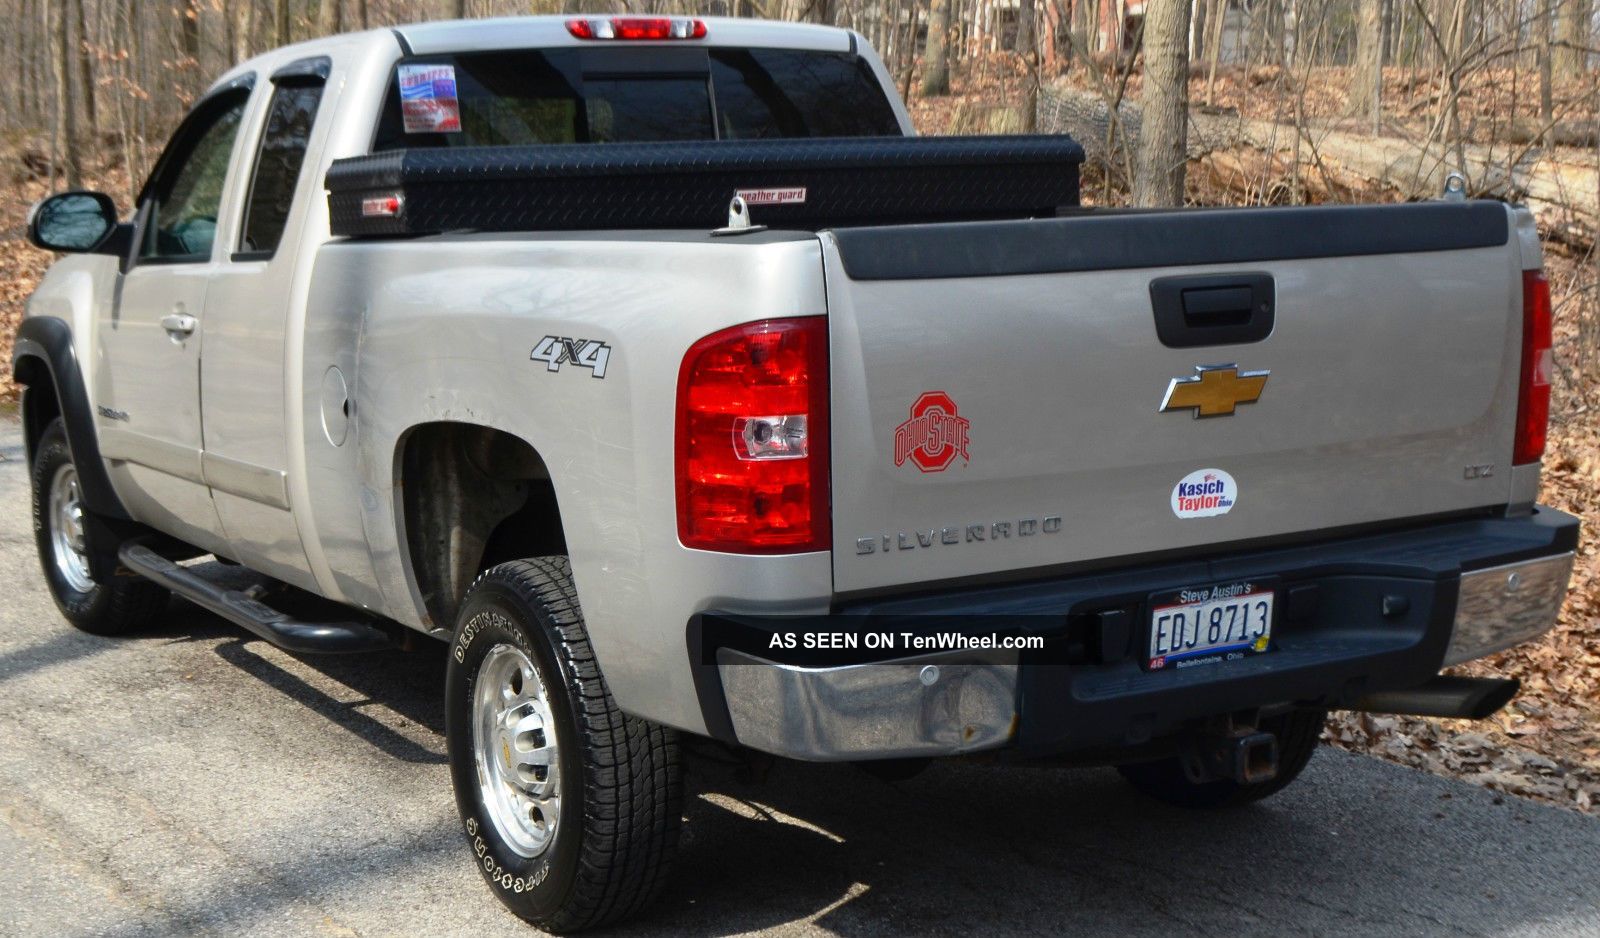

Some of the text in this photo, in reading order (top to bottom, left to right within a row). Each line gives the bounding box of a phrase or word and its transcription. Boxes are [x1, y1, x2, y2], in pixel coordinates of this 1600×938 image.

[777, 190, 803, 201] guard
[1178, 480, 1224, 497] Kasich
[1178, 495, 1219, 511] Taylor
[856, 516, 1062, 556] SILVERADO
[1180, 590, 1209, 604] Steve
[1211, 582, 1252, 600] Austin's
[1156, 601, 1268, 655] EDJ 8713
[1151, 657, 1165, 669] 46
[1226, 652, 1244, 661] Ohio
